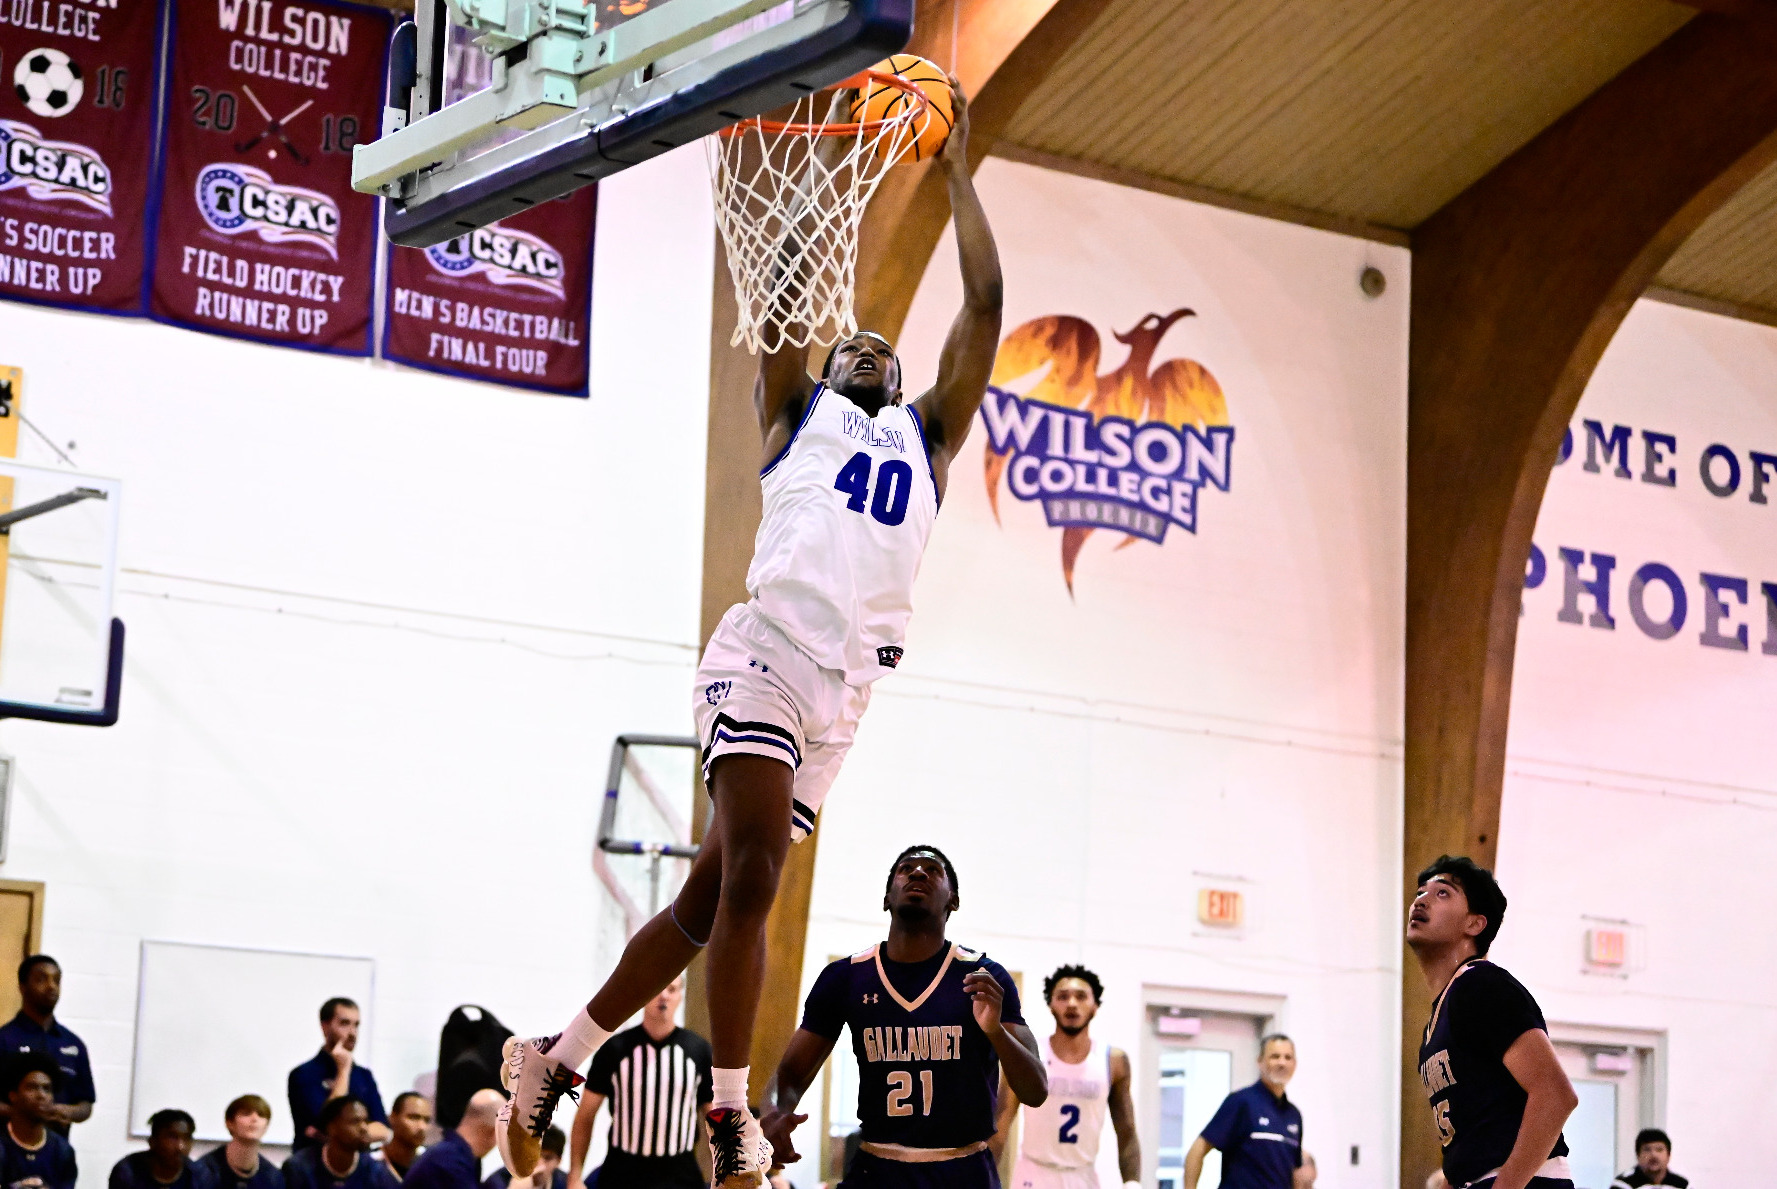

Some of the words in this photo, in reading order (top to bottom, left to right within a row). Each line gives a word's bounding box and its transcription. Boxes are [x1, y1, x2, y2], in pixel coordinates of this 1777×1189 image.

[218, 0, 351, 56] WILSON
[229, 40, 331, 89] COLLEGE
[191, 85, 237, 132] 20
[321, 113, 360, 154] 18
[9, 139, 107, 194] CSAC
[241, 184, 339, 235] CSAC
[23, 221, 116, 260] SOCCER
[471, 228, 560, 278] CSAC
[68, 266, 102, 295] UP
[182, 246, 249, 288] FIELD
[254, 262, 344, 302] HOCKEY
[195, 287, 290, 333] RUNNER
[297, 307, 328, 335] UP
[394, 287, 452, 323] MEN'S
[455, 302, 580, 346] BASKETBALL
[428, 332, 490, 367] FINAL
[495, 345, 548, 375] FOUR
[981, 390, 1230, 488] WILSON
[834, 451, 912, 526] 40
[1011, 455, 1194, 526] COLLEGE
[1699, 443, 1777, 505] OF
[1051, 500, 1160, 538] PHOENIX
[863, 1025, 963, 1062] GALLAUDET
[886, 1069, 933, 1117] 21
[1058, 1103, 1080, 1144] 2
